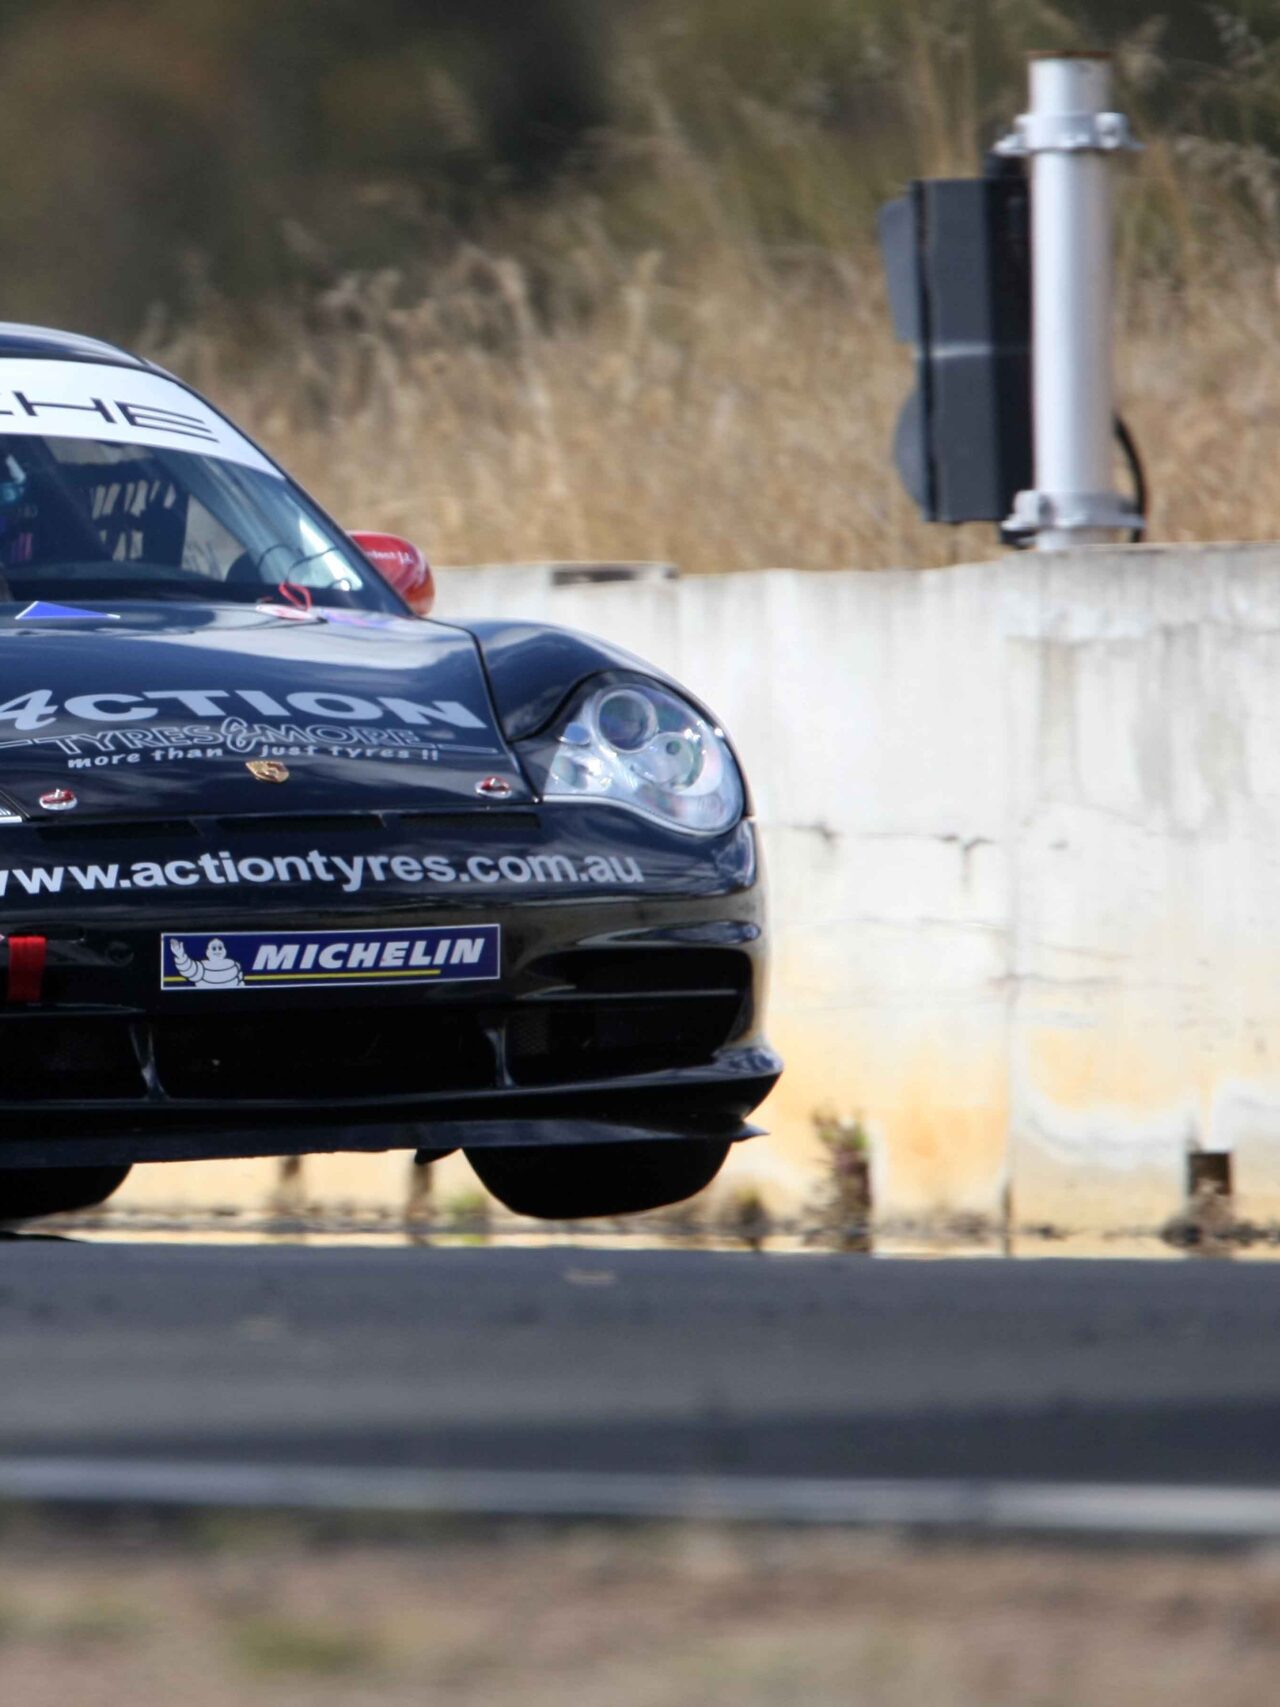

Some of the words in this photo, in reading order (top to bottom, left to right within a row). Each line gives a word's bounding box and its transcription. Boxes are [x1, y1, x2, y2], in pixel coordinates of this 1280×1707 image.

[67, 753, 140, 769] more
[153, 746, 223, 760] than
[260, 744, 321, 758] just
[328, 744, 411, 760] tyres
[250, 937, 487, 973] MICHELIN
